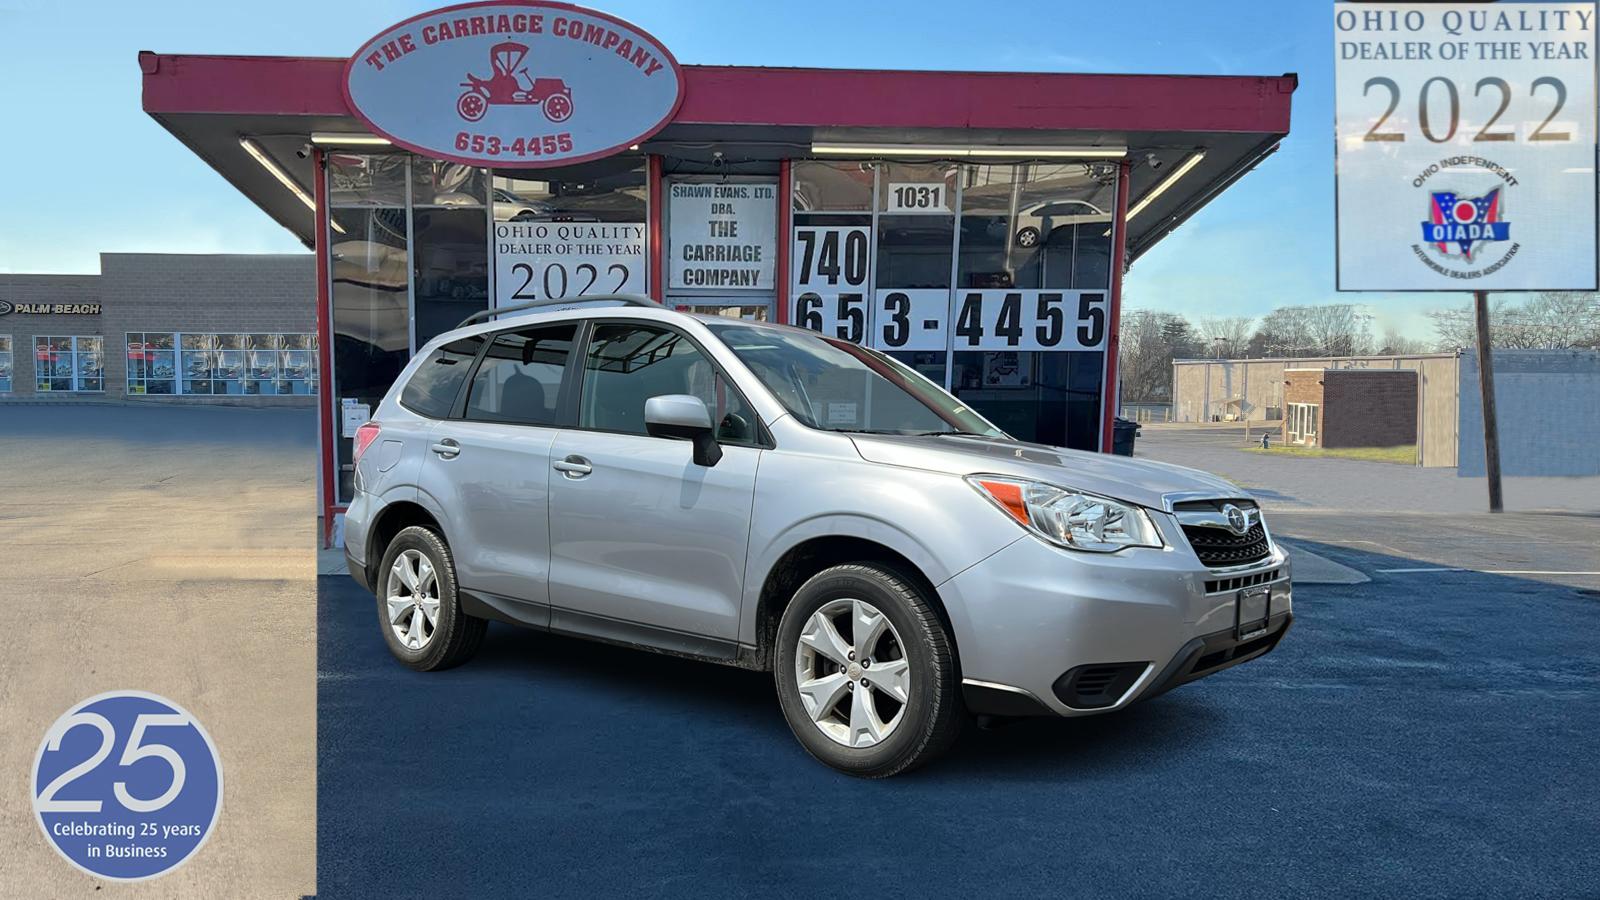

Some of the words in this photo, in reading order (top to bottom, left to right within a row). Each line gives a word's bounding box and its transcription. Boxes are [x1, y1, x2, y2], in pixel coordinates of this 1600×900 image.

[1336, 9, 1425, 31] OHIO
[1442, 9, 1593, 36] QUALITY
[365, 33, 417, 72] THE
[421, 14, 544, 46] CARRIAGE
[552, 17, 664, 77] COMPANY
[1340, 41, 1433, 60] DEALER
[1438, 41, 1469, 60] OF
[1474, 41, 1522, 60] THE
[1528, 41, 1589, 60] YEAR
[1362, 75, 1571, 143] 2022
[454, 131, 573, 157] 653-4455
[1412, 163, 1440, 188] OHIO
[1439, 155, 1519, 187] INDEPENDENT
[672, 186, 712, 198] SHAWN
[754, 187, 775, 199] LTD.
[894, 186, 941, 209] 1031
[711, 203, 736, 215] DBA.
[496, 225, 548, 239] OHIO
[557, 225, 645, 241] QUALITY
[708, 220, 738, 238] THE
[1432, 224, 1496, 240] OIADA
[499, 243, 552, 255] DEALER
[555, 243, 573, 255] OF
[576, 243, 604, 255] THE
[605, 243, 642, 255] YEAR
[682, 244, 763, 262] CARRIAGE
[797, 229, 868, 286] 740
[510, 262, 631, 300] 2022
[683, 268, 761, 286] COMPANY
[14, 303, 51, 315] PALM
[54, 303, 101, 315] BEACH
